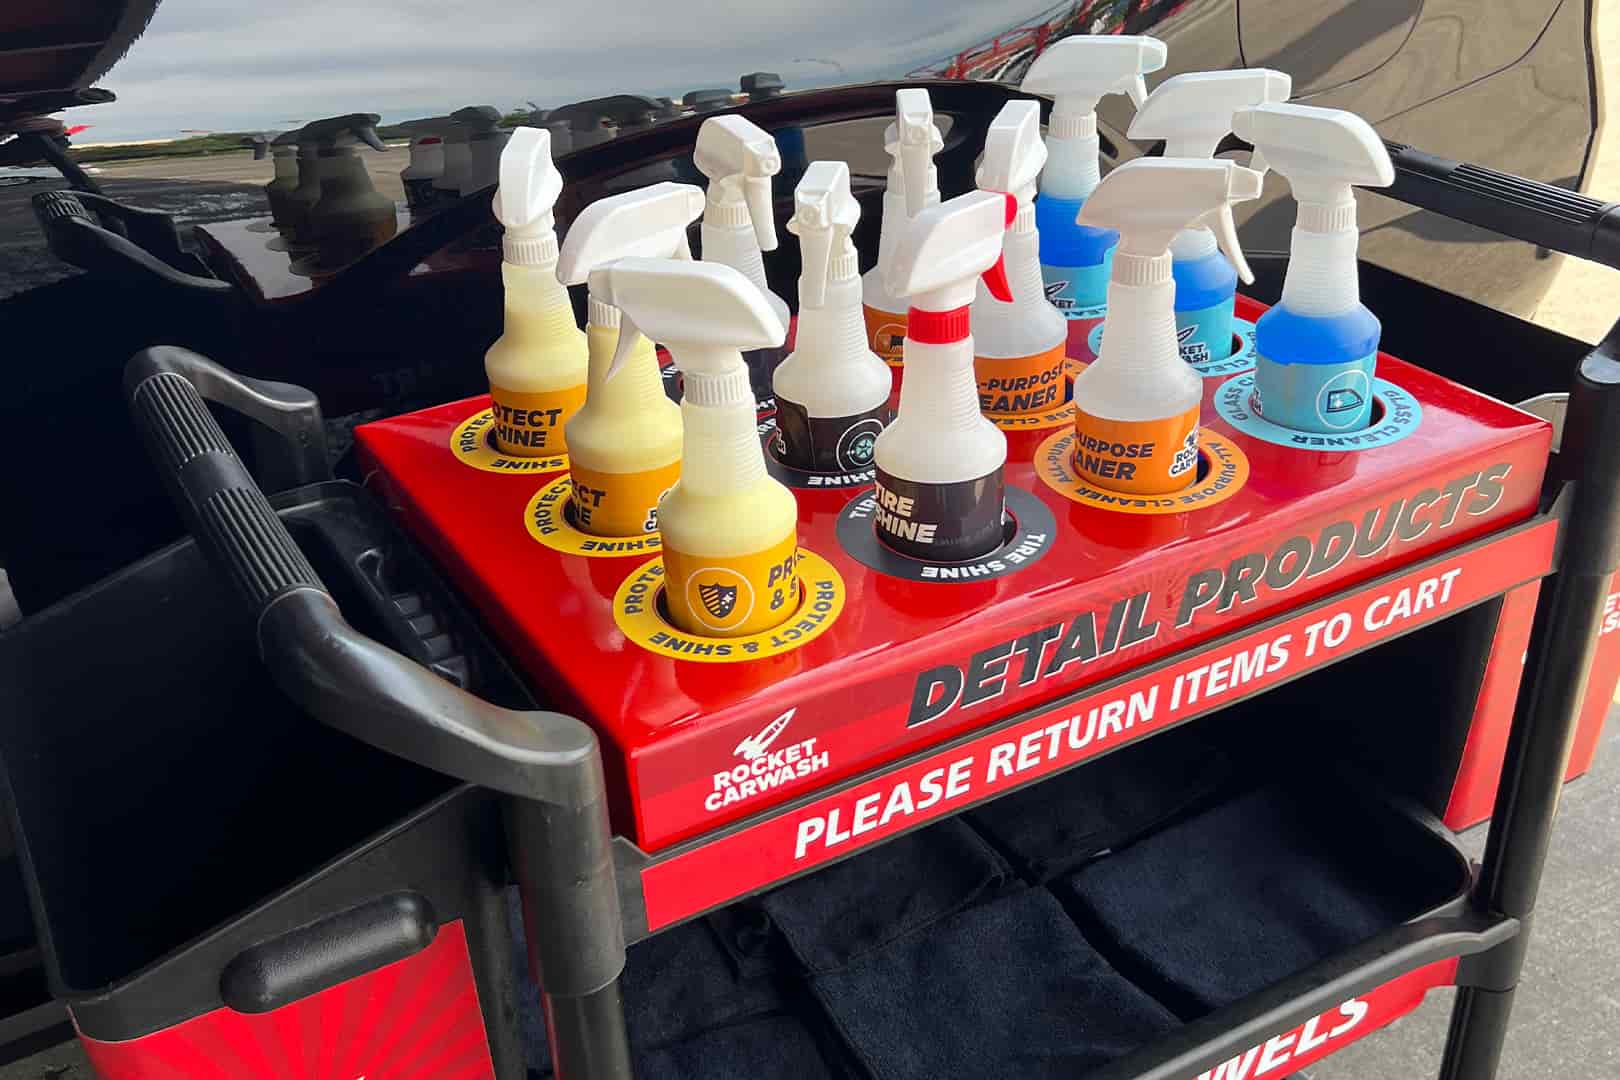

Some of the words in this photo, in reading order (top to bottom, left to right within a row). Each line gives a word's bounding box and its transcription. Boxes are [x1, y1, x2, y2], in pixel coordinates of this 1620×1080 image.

[1381, 389, 1414, 425] GLASS
[1291, 424, 1401, 446] CLEANER
[490, 458, 565, 469] SHINE
[875, 480, 914, 518] TIRE
[1074, 487, 1176, 508] CLEANER
[875, 504, 938, 544] SHINE
[579, 537, 661, 552] SHINE
[1004, 533, 1047, 565] TIRE
[921, 563, 1007, 579] SHINE
[771, 580, 835, 645] PROTECT
[905, 596, 1162, 729] DETAIL
[1175, 463, 1513, 628] PRODUCTS
[648, 631, 734, 656] SHINE
[743, 641, 759, 654] &
[794, 757, 974, 860] PLEASE
[986, 683, 1159, 784] RETURN
[1169, 634, 1292, 713] ITEMS
[1303, 612, 1353, 657] TO
[1363, 569, 1461, 632] CART
[704, 751, 829, 811] CARWASH
[713, 738, 817, 792] ROCKET
